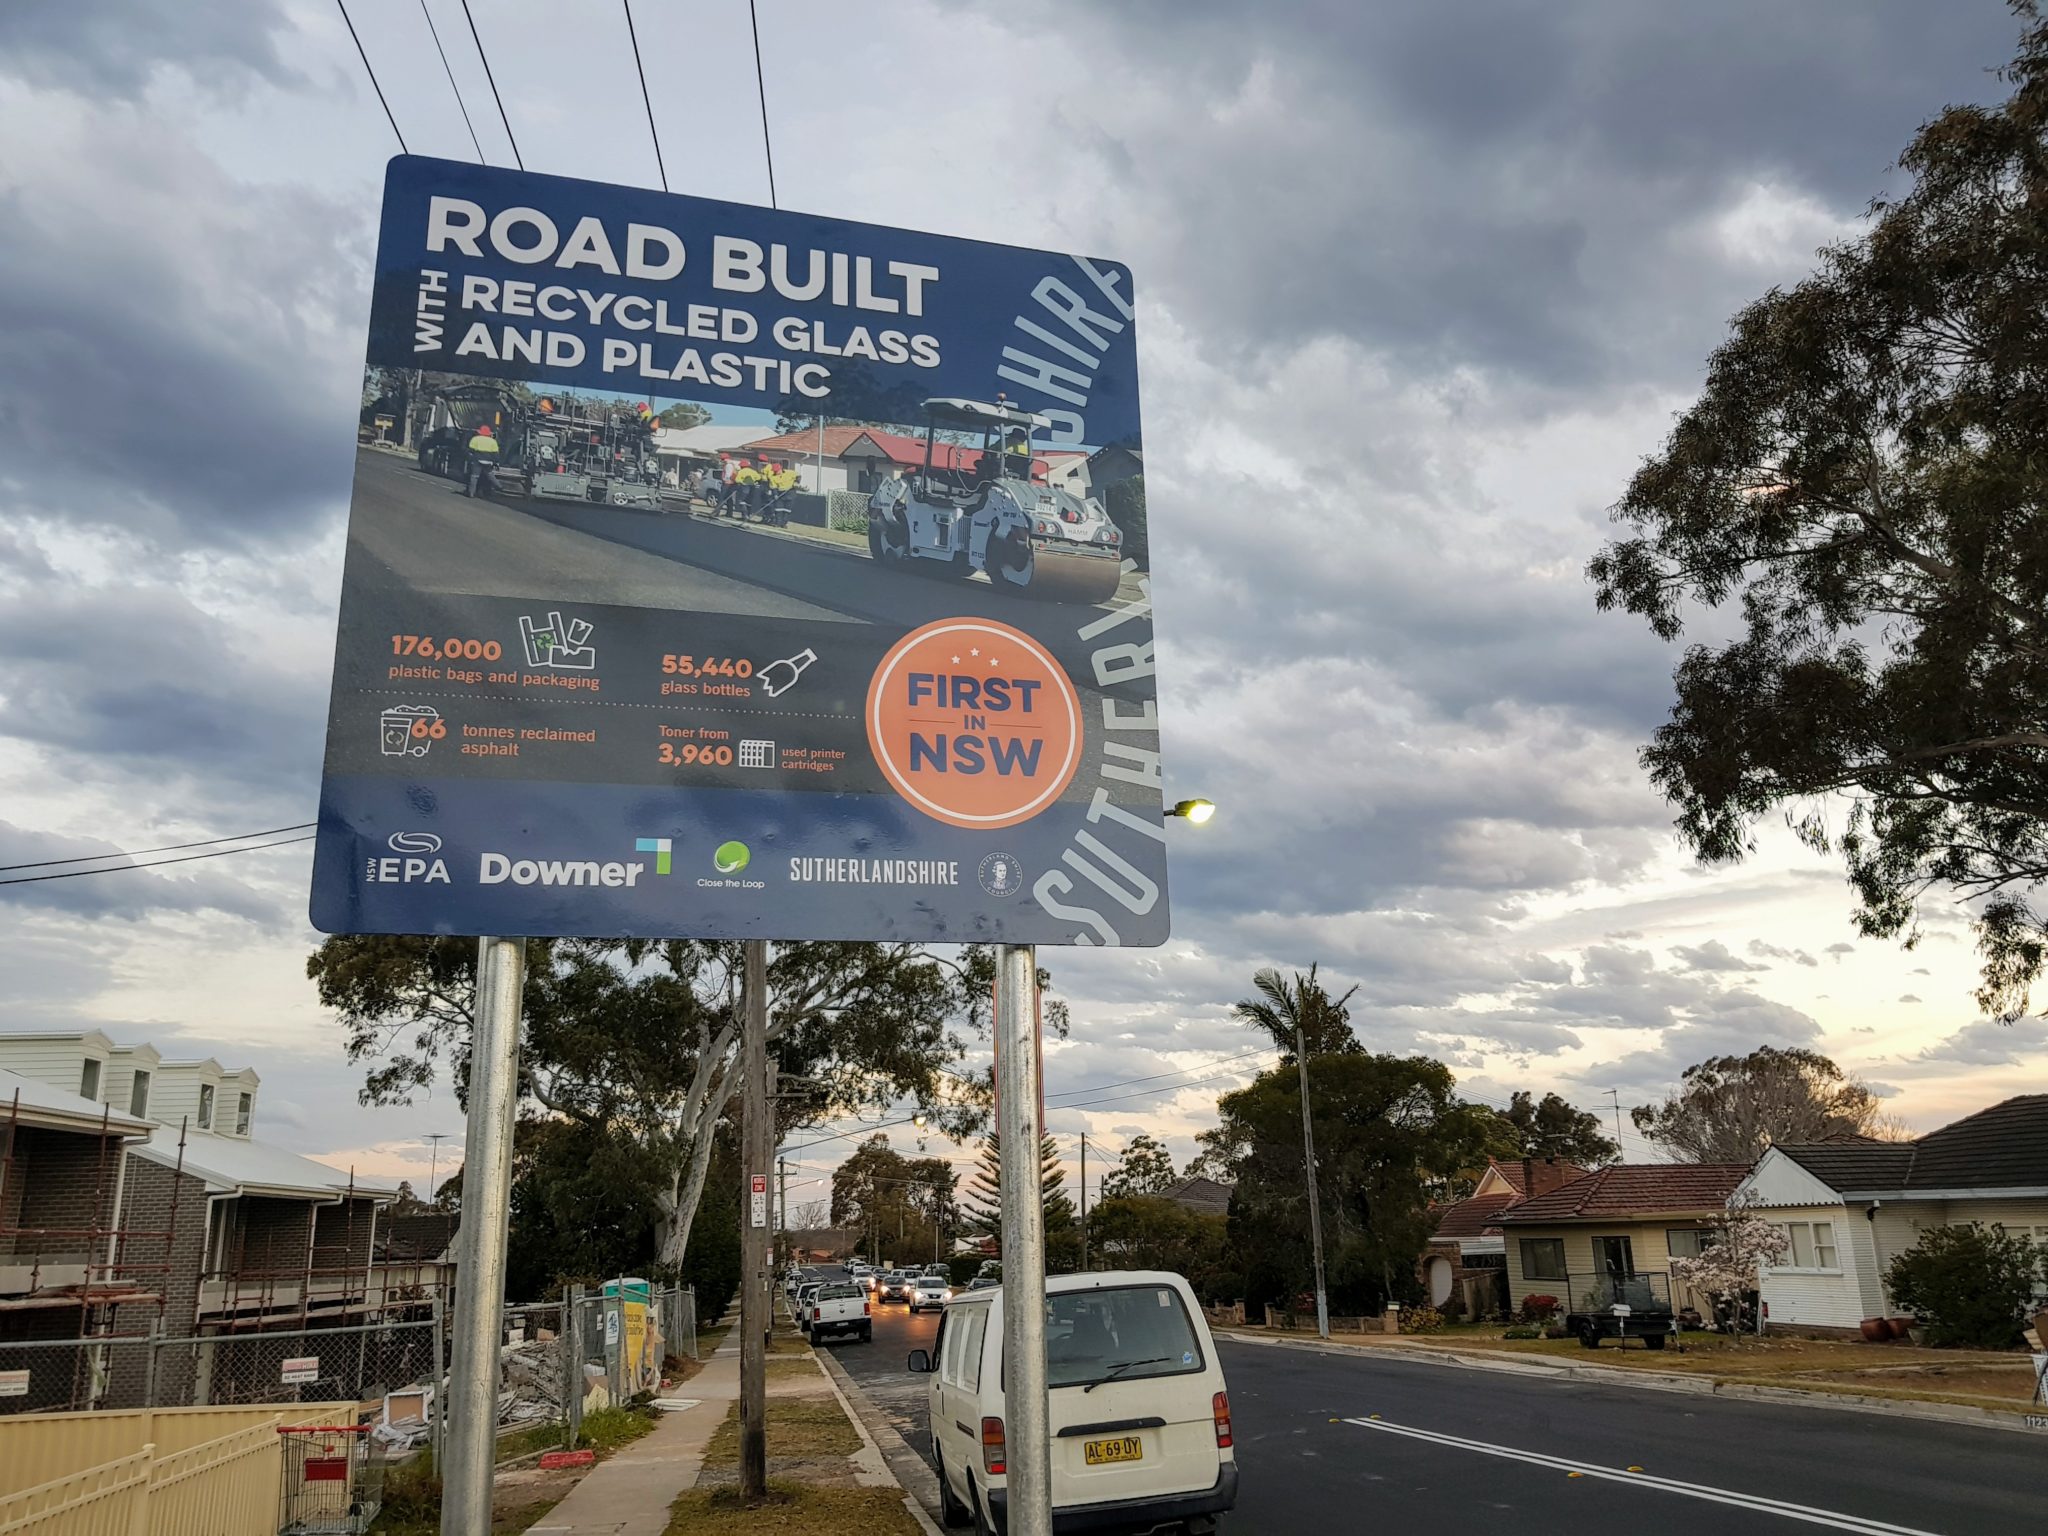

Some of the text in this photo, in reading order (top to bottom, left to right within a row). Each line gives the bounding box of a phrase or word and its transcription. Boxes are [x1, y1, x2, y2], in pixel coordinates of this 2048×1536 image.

[426, 195, 940, 317] ROAD BUILT
[413, 269, 448, 353] WITH
[461, 275, 941, 368] RECYCLED GLASS
[455, 323, 832, 398] AND PLASTIC
[391, 634, 502, 661] 176,000
[388, 664, 600, 691] plastic bags and packaging
[662, 654, 753, 678] 55,440
[661, 681, 751, 697] glass bottles
[908, 672, 1042, 713] FIRST
[411, 718, 447, 740] 66
[462, 724, 596, 742] tonnes reclaimed
[658, 725, 729, 740] Toner from
[964, 715, 986, 730] IN
[461, 742, 519, 757] asphalt
[658, 743, 733, 766] 3,960
[782, 748, 846, 760] used printer
[909, 732, 1044, 777] NSW
[782, 760, 834, 773] cartridges
[366, 857, 377, 882] NSW
[379, 857, 451, 883] EPA
[479, 852, 644, 887] Downer
[790, 857, 959, 885] SUTHERLANDSHIRE
[697, 878, 765, 889] Close the Loop
